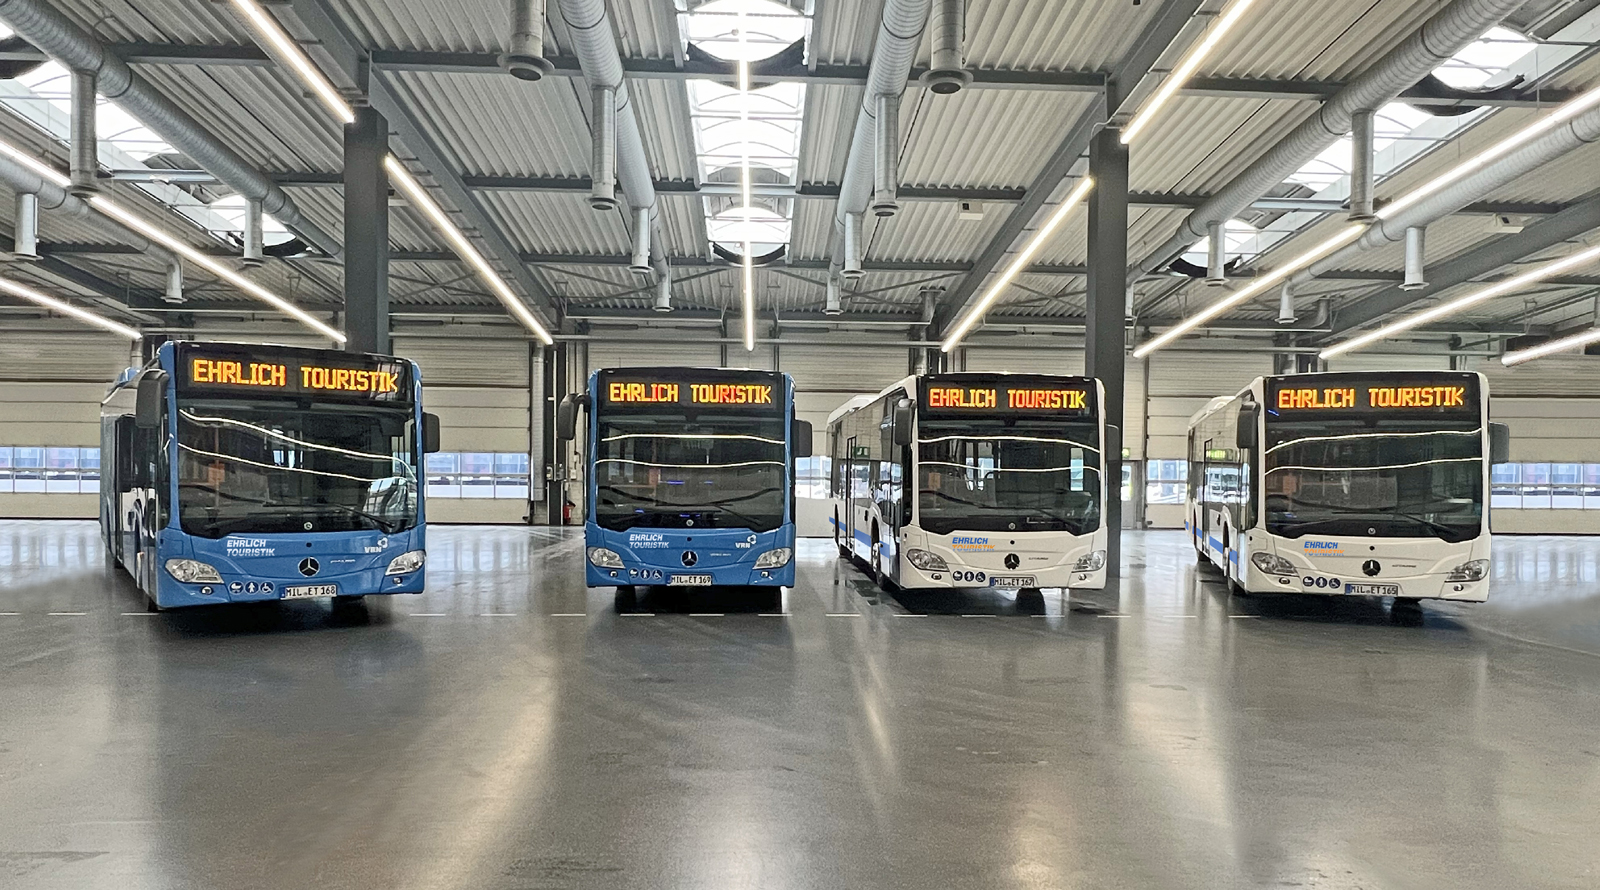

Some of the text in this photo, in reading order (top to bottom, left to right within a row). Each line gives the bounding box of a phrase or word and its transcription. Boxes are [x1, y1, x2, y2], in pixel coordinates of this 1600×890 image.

[193, 359, 398, 393] EHRLICH TOURISTIK
[609, 383, 772, 404] EHRLICH TOURISTIK
[929, 388, 1086, 409] EHRLICH TOURISTIK
[1278, 387, 1465, 409] EHRLICH TOURISTIK
[226, 539, 267, 548] EHRLICH
[629, 541, 669, 549] TOURISTIK
[1303, 541, 1339, 549] EHRLICH
[226, 548, 276, 557] TOURISTIK
[286, 585, 336, 597] MIL ET 168
[1350, 585, 1396, 595] MIL ET 165
